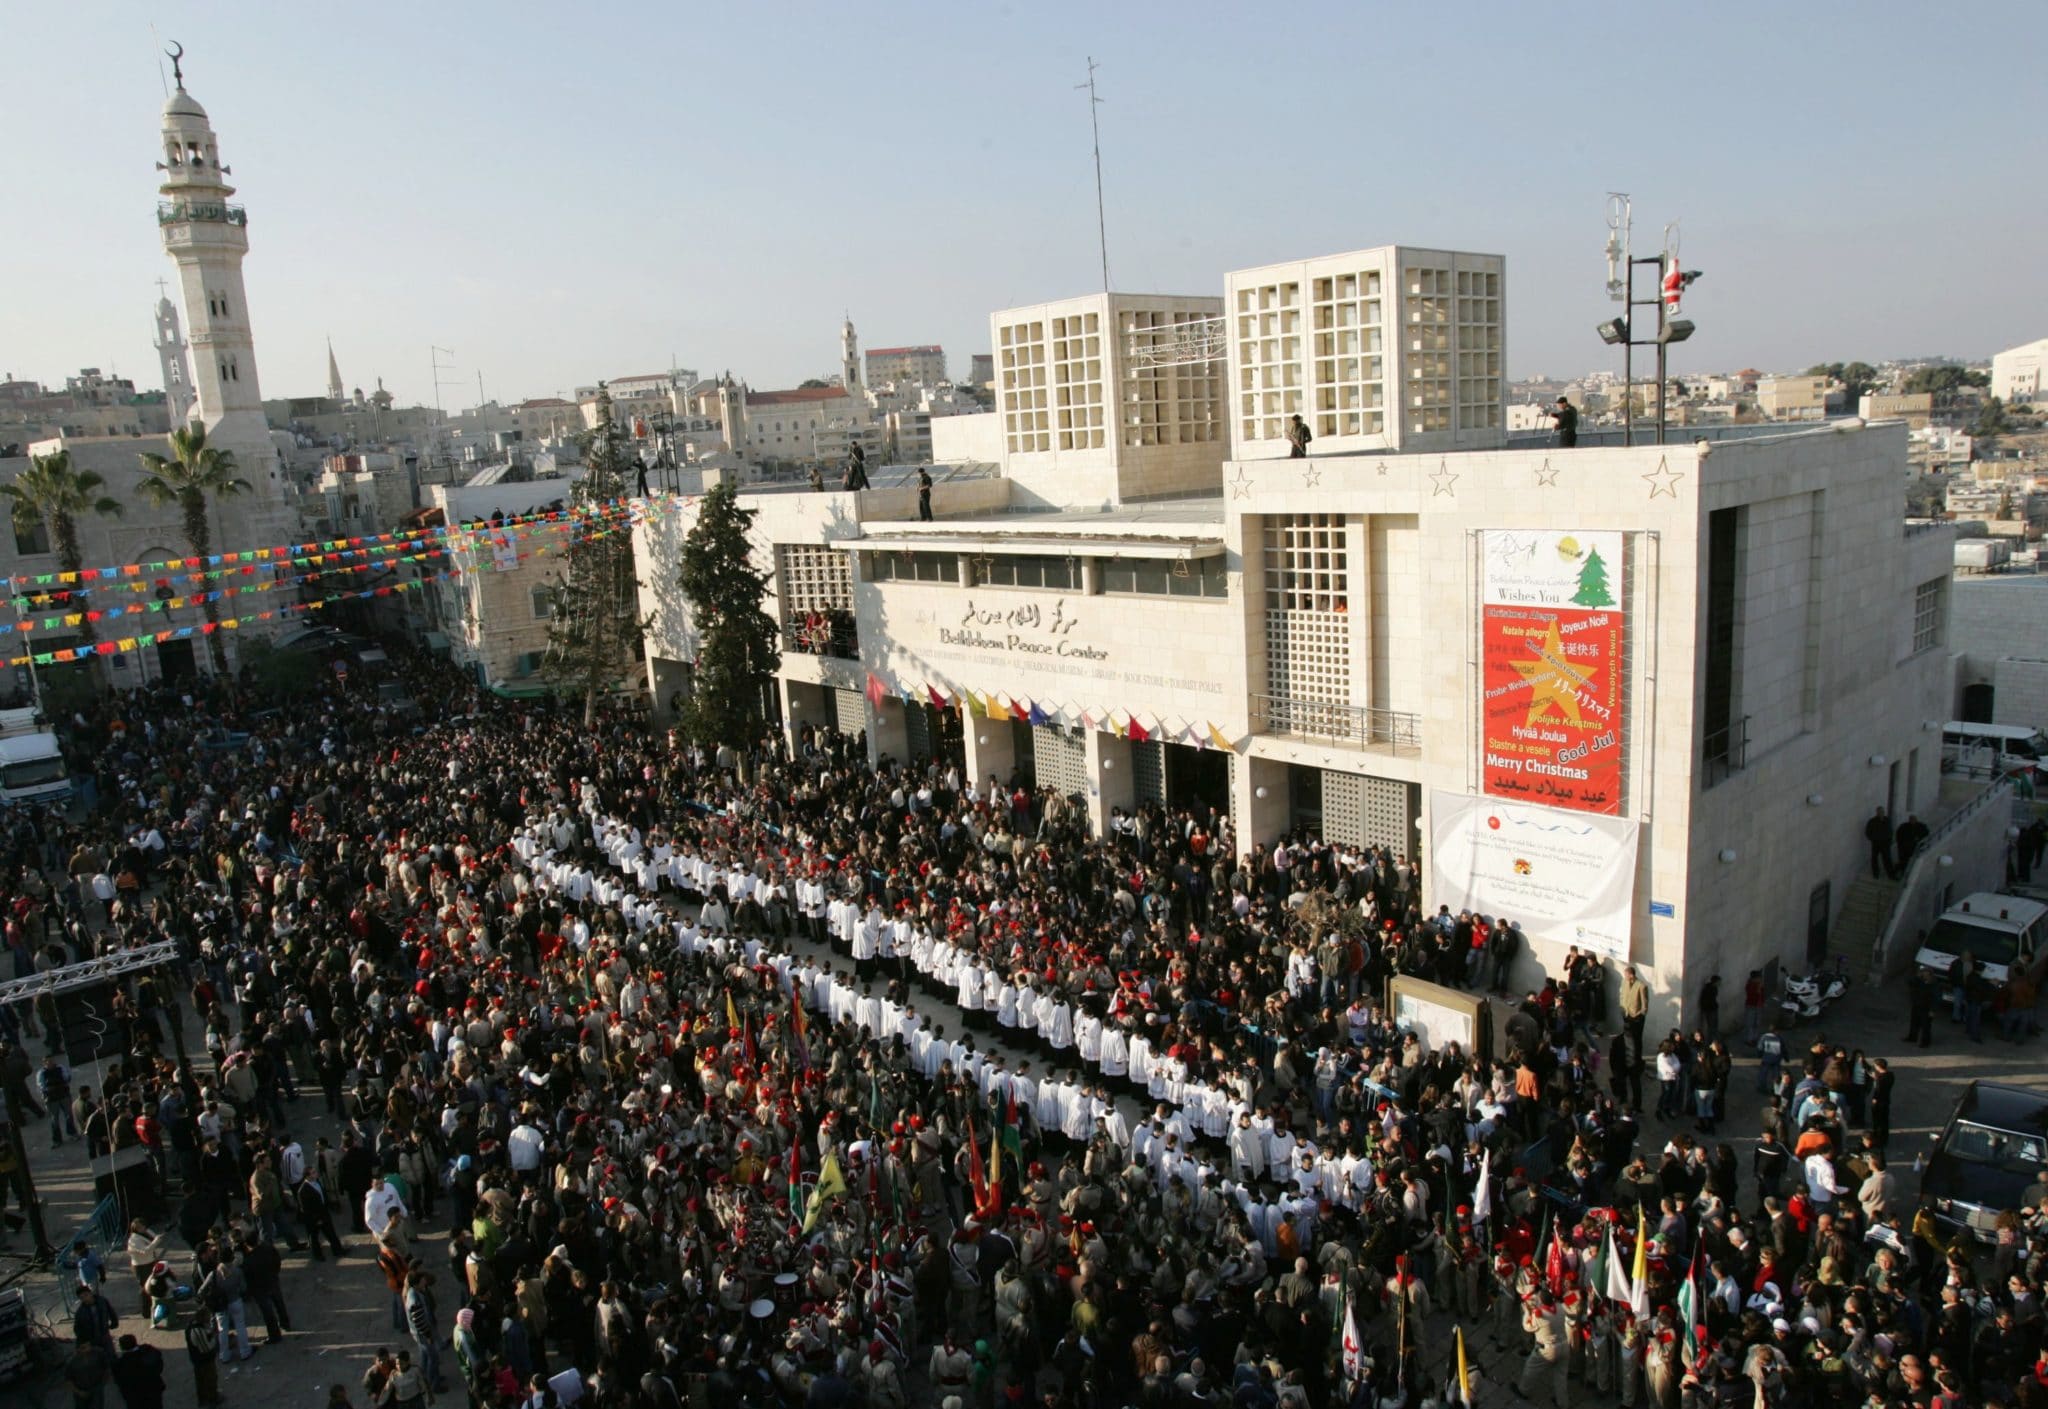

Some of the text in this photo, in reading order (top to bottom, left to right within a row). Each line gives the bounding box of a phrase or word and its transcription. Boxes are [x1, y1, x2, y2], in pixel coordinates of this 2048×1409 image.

[1498, 587, 1560, 603] Wishes You
[1502, 625, 1550, 639] Natale allegro
[1560, 613, 1609, 635] Joyeux Noël
[939, 628, 1109, 661] Bethlehem Peace Center
[1557, 641, 1600, 656] 圣诞快乐
[1170, 677, 1198, 689] TOURIST
[1199, 680, 1223, 693] POLICE
[1485, 687, 1507, 698] Frohe
[1553, 678, 1611, 720] メリークリスマス
[1529, 713, 1603, 730] Vrolijke Kerstmis
[1512, 725, 1567, 743] Hyvää Joulua
[1557, 730, 1616, 764] God Jul
[1487, 753, 1588, 780] Merry Christmas
[1494, 777, 1606, 807] عيد ميلاد سعيد
